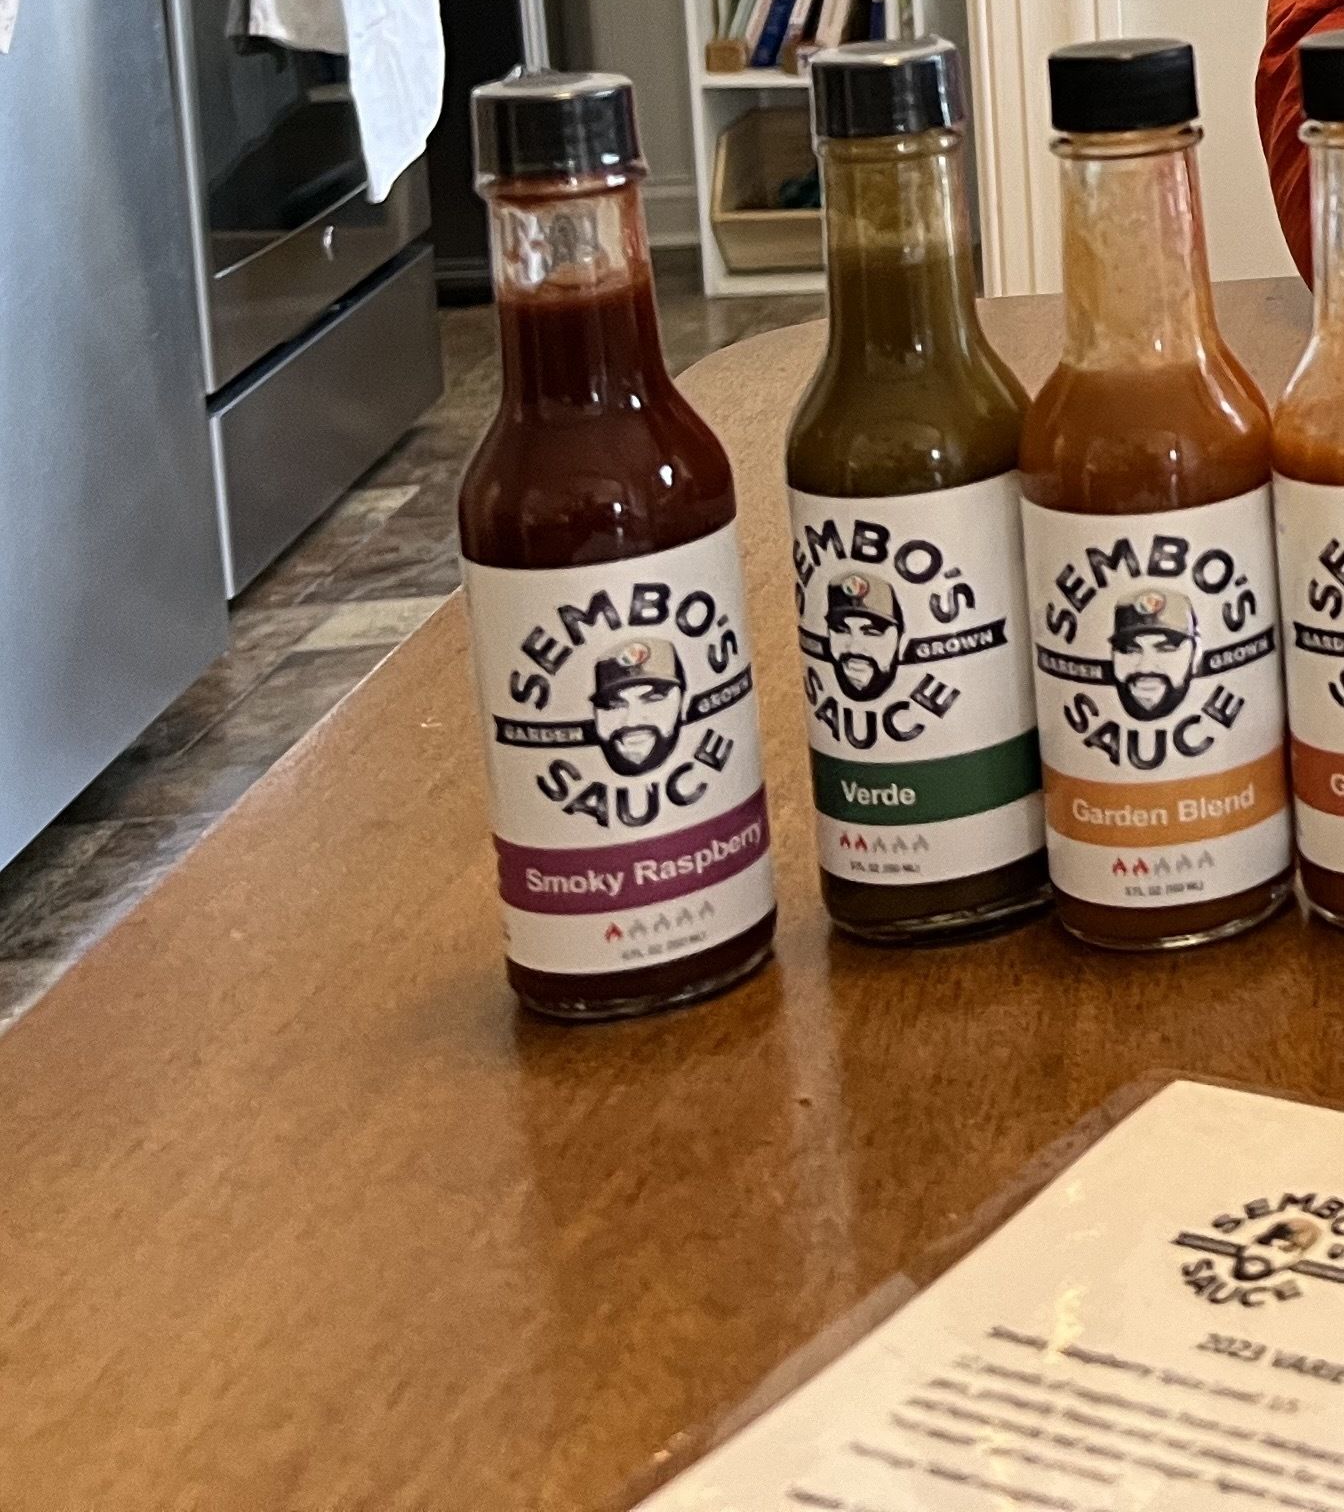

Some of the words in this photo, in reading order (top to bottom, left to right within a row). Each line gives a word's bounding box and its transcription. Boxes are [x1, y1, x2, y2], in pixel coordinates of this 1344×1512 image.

[1045, 533, 1258, 645] SEMBO'S
[510, 582, 738, 710] SEMBO'S
[915, 628, 995, 660] GROWN
[1208, 635, 1270, 671] GROWN
[803, 665, 962, 751] SAUCE
[1062, 684, 1246, 771] SAUCE
[536, 727, 734, 829] SAUCE
[840, 778, 917, 808] Verde
[1071, 797, 1169, 829] Garden
[1177, 785, 1257, 824] Blend
[525, 867, 624, 897] Smoky
[633, 819, 763, 886] Raspberry
[1181, 1256, 1303, 1309] SAUCE
